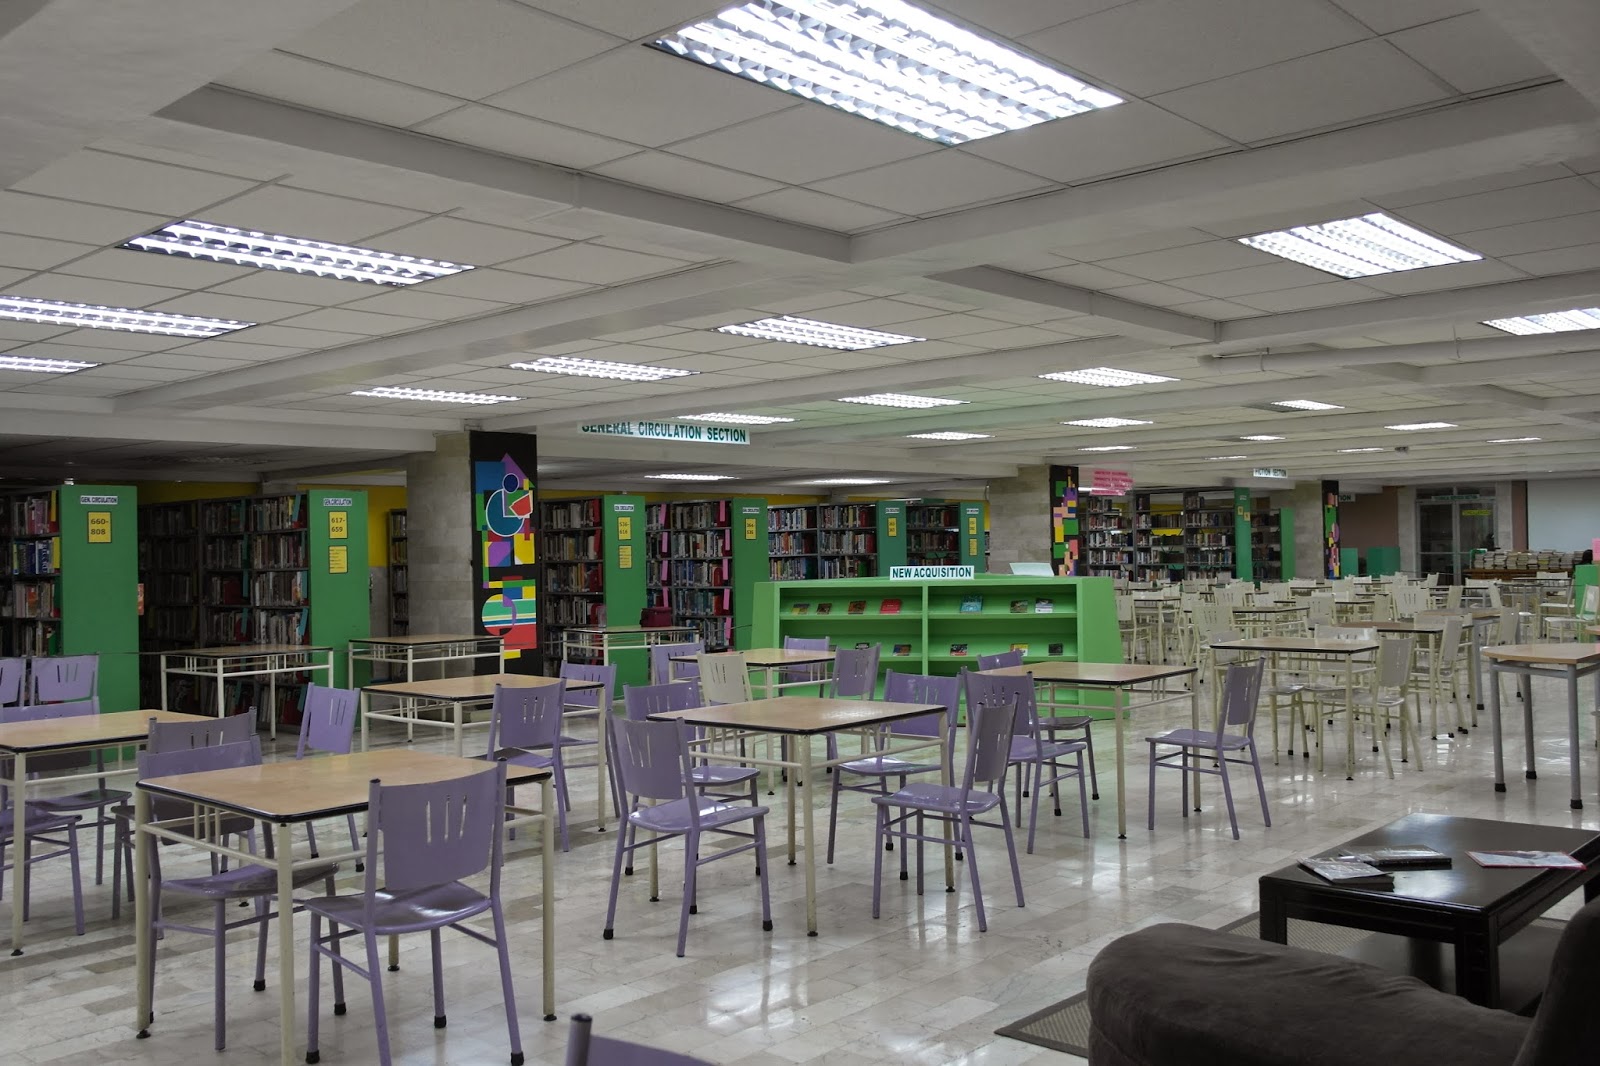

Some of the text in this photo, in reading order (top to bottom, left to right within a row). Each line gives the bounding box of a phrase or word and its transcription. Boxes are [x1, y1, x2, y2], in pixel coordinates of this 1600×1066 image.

[638, 421, 701, 440] CIRCULATION
[707, 427, 746, 442] SECTION
[892, 567, 972, 578] NEW ACQUISITION
